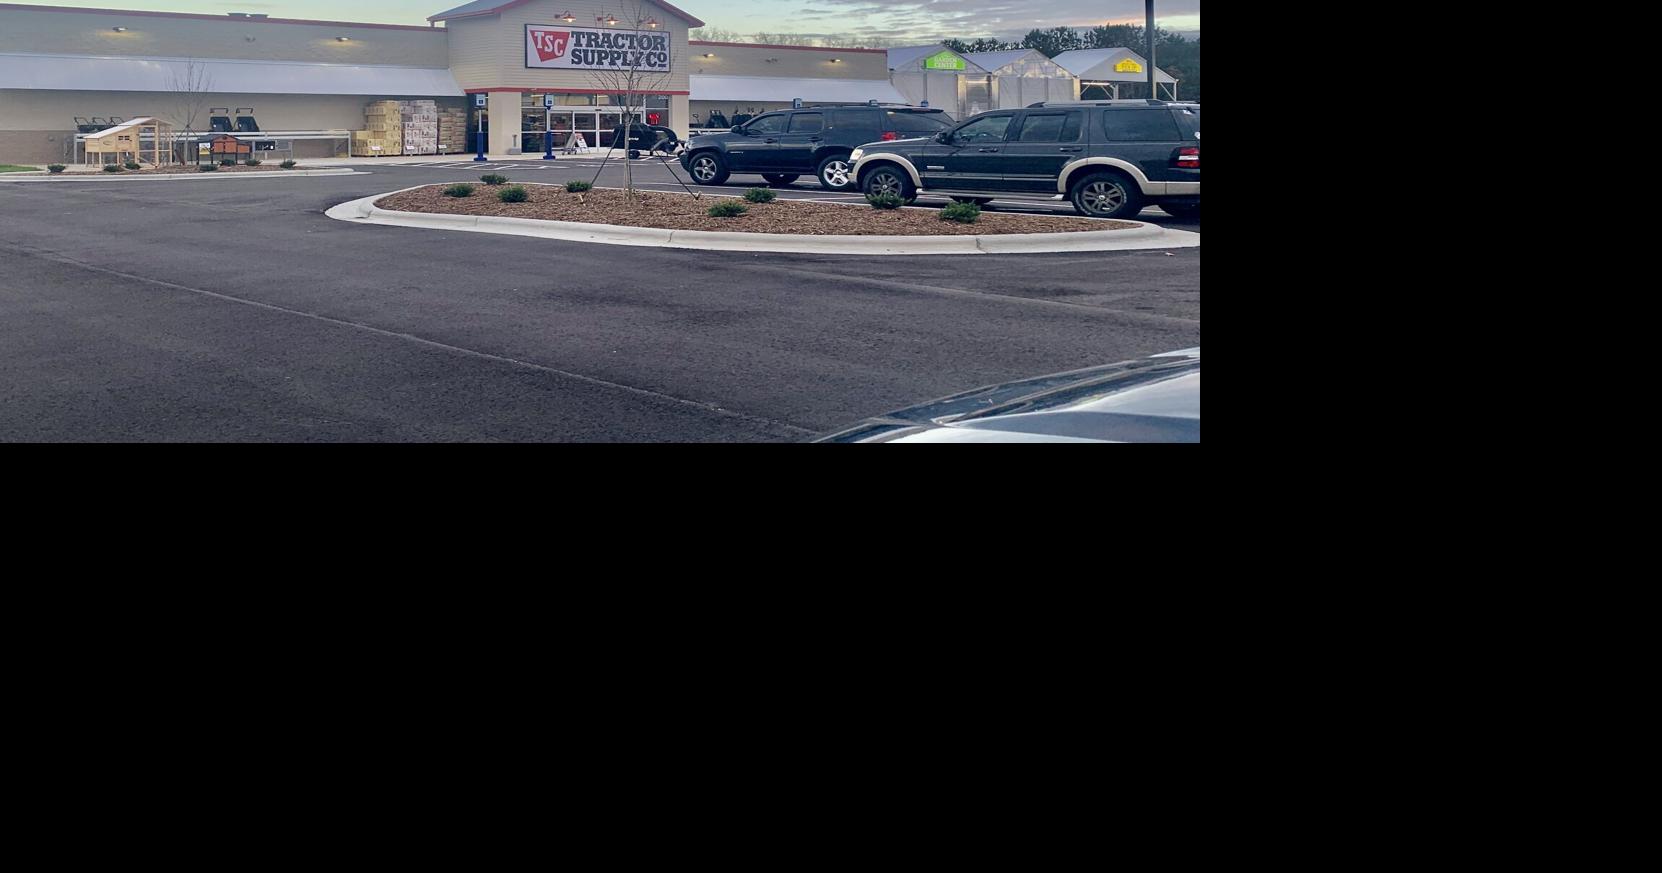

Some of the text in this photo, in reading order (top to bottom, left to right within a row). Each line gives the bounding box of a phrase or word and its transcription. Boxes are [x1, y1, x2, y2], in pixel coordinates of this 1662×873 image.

[534, 31, 564, 56] TSC
[571, 31, 666, 51] TRACTOR
[571, 48, 642, 67] SUPPLY
